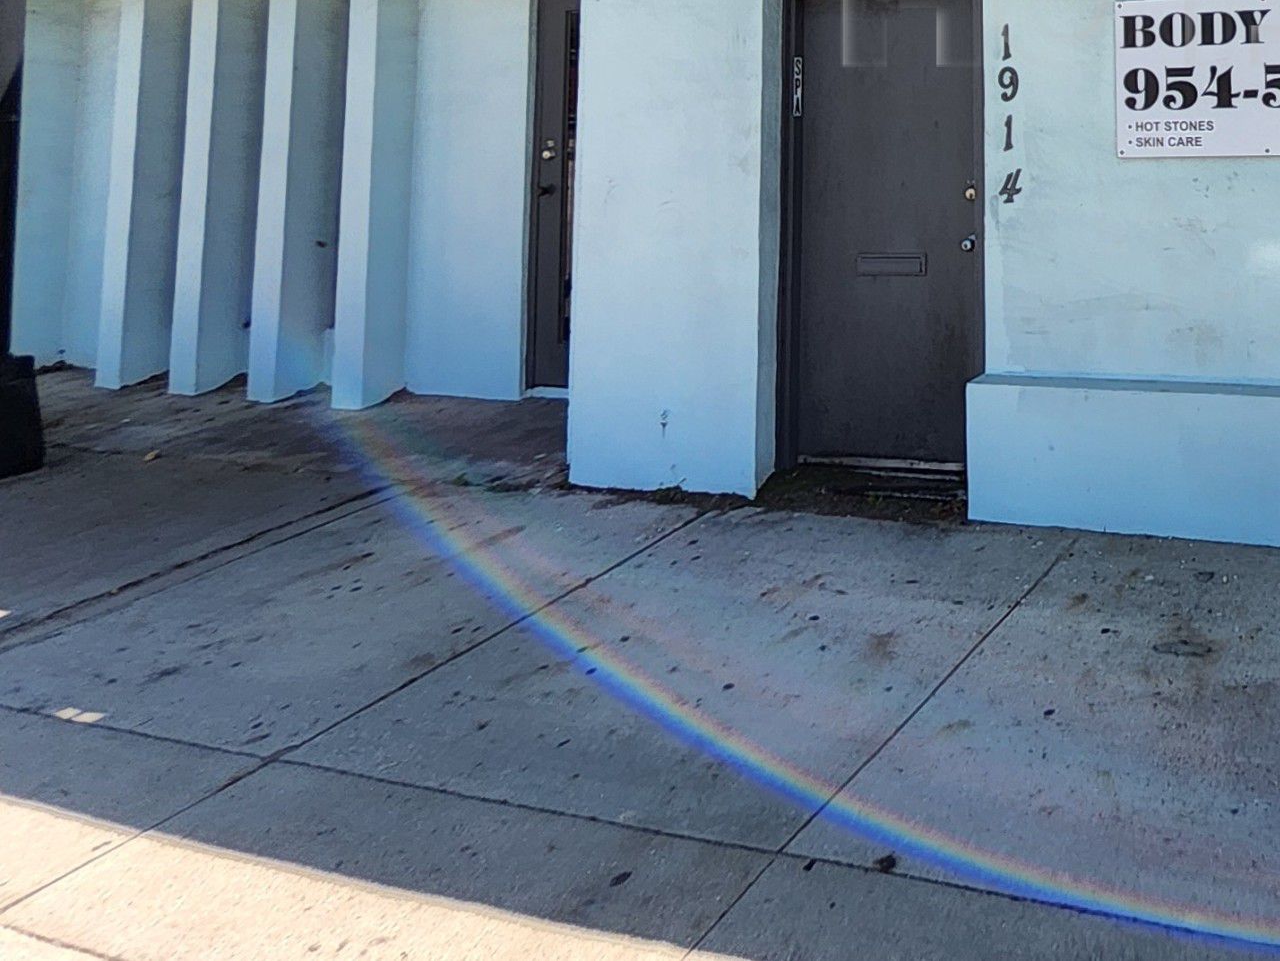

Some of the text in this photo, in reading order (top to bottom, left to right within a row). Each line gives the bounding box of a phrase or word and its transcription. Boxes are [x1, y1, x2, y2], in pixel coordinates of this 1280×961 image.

[1120, 9, 1271, 49] BODY
[794, 58, 802, 115] SPA
[998, 24, 1022, 203] 1914
[1135, 120, 1214, 132] HOT STONES
[1135, 136, 1203, 147] SKIN CARE
